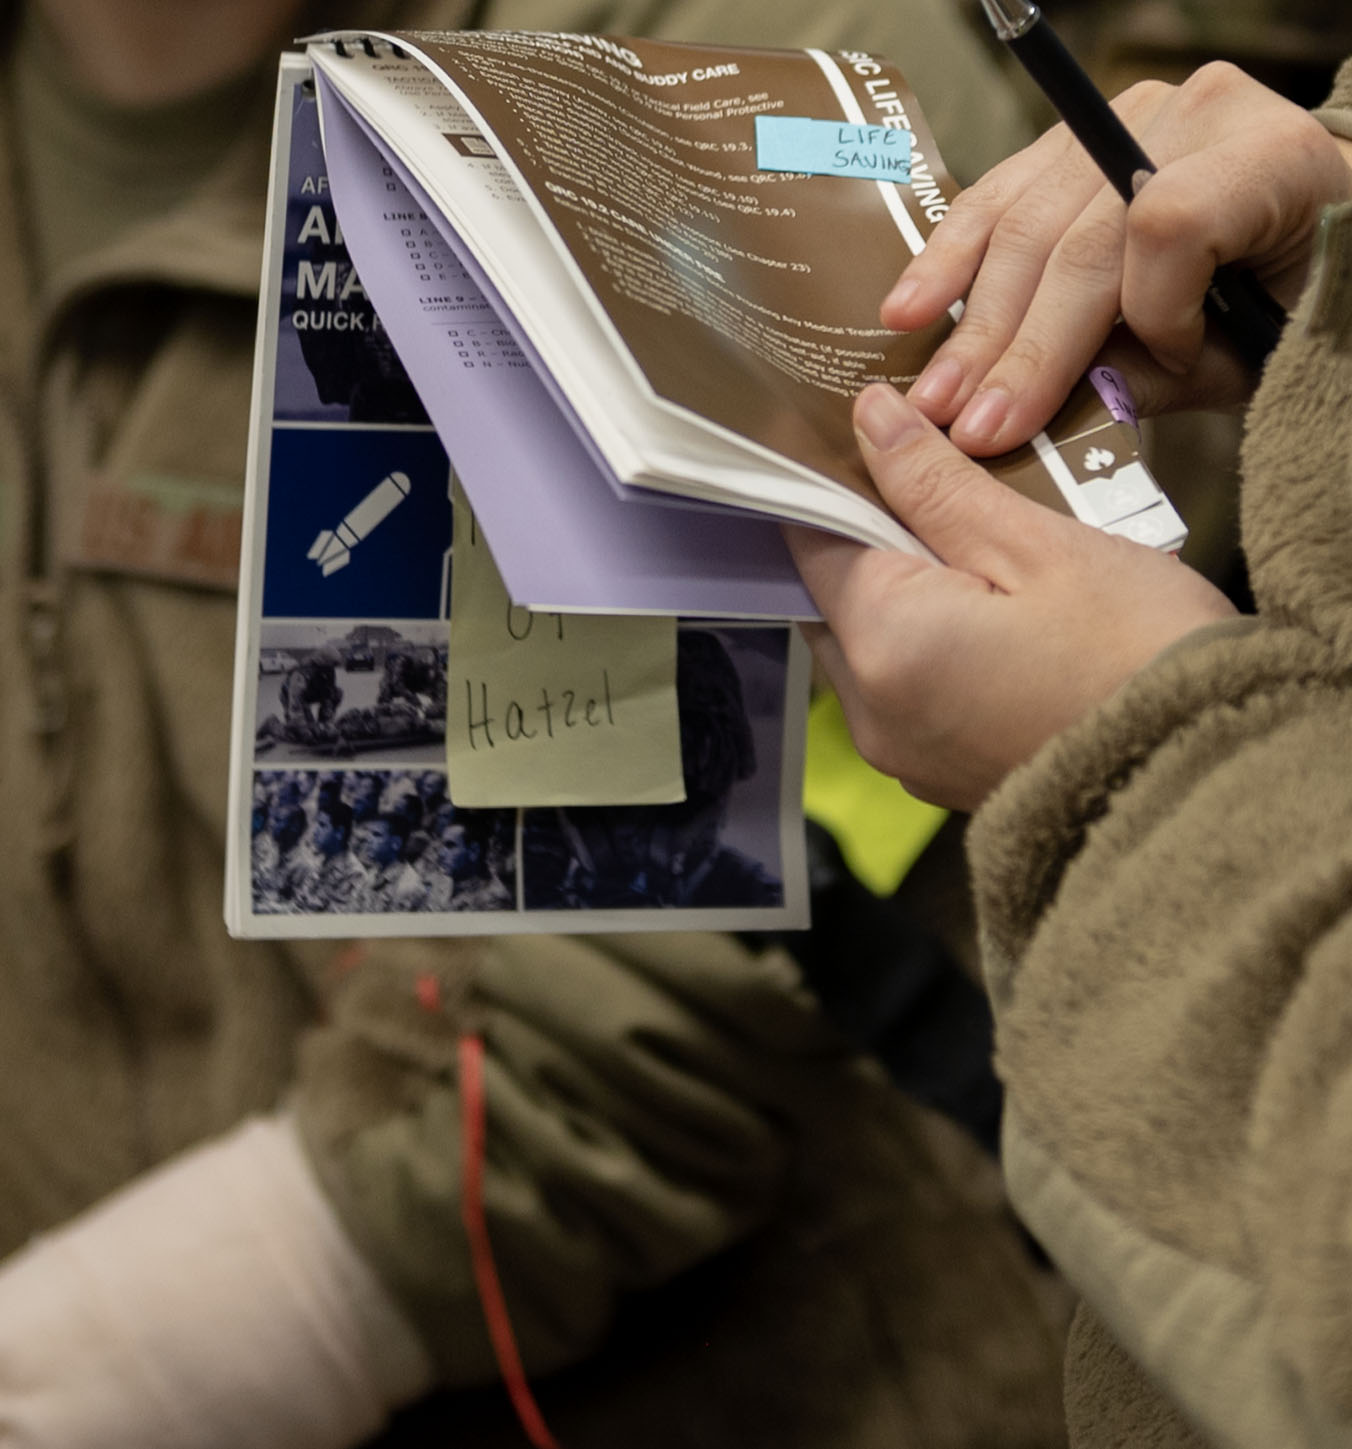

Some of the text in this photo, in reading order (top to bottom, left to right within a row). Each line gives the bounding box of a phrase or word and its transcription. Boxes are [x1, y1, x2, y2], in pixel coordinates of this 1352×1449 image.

[633, 70, 688, 86] BUDDY
[692, 63, 740, 82] CARE
[675, 109, 723, 121] Personal
[726, 99, 785, 117] Protective
[683, 101, 711, 111] Field
[713, 96, 746, 109] Care,
[748, 92, 769, 102] see
[694, 140, 720, 152] QRC
[838, 127, 897, 145] LIFE
[832, 149, 911, 176] SAVING
[750, 173, 777, 185] QRC
[545, 181, 578, 202] QRC
[419, 296, 452, 304] LINE
[292, 309, 365, 331] QUICK
[803, 320, 846, 335] Medical
[465, 668, 615, 751] Hatzel
